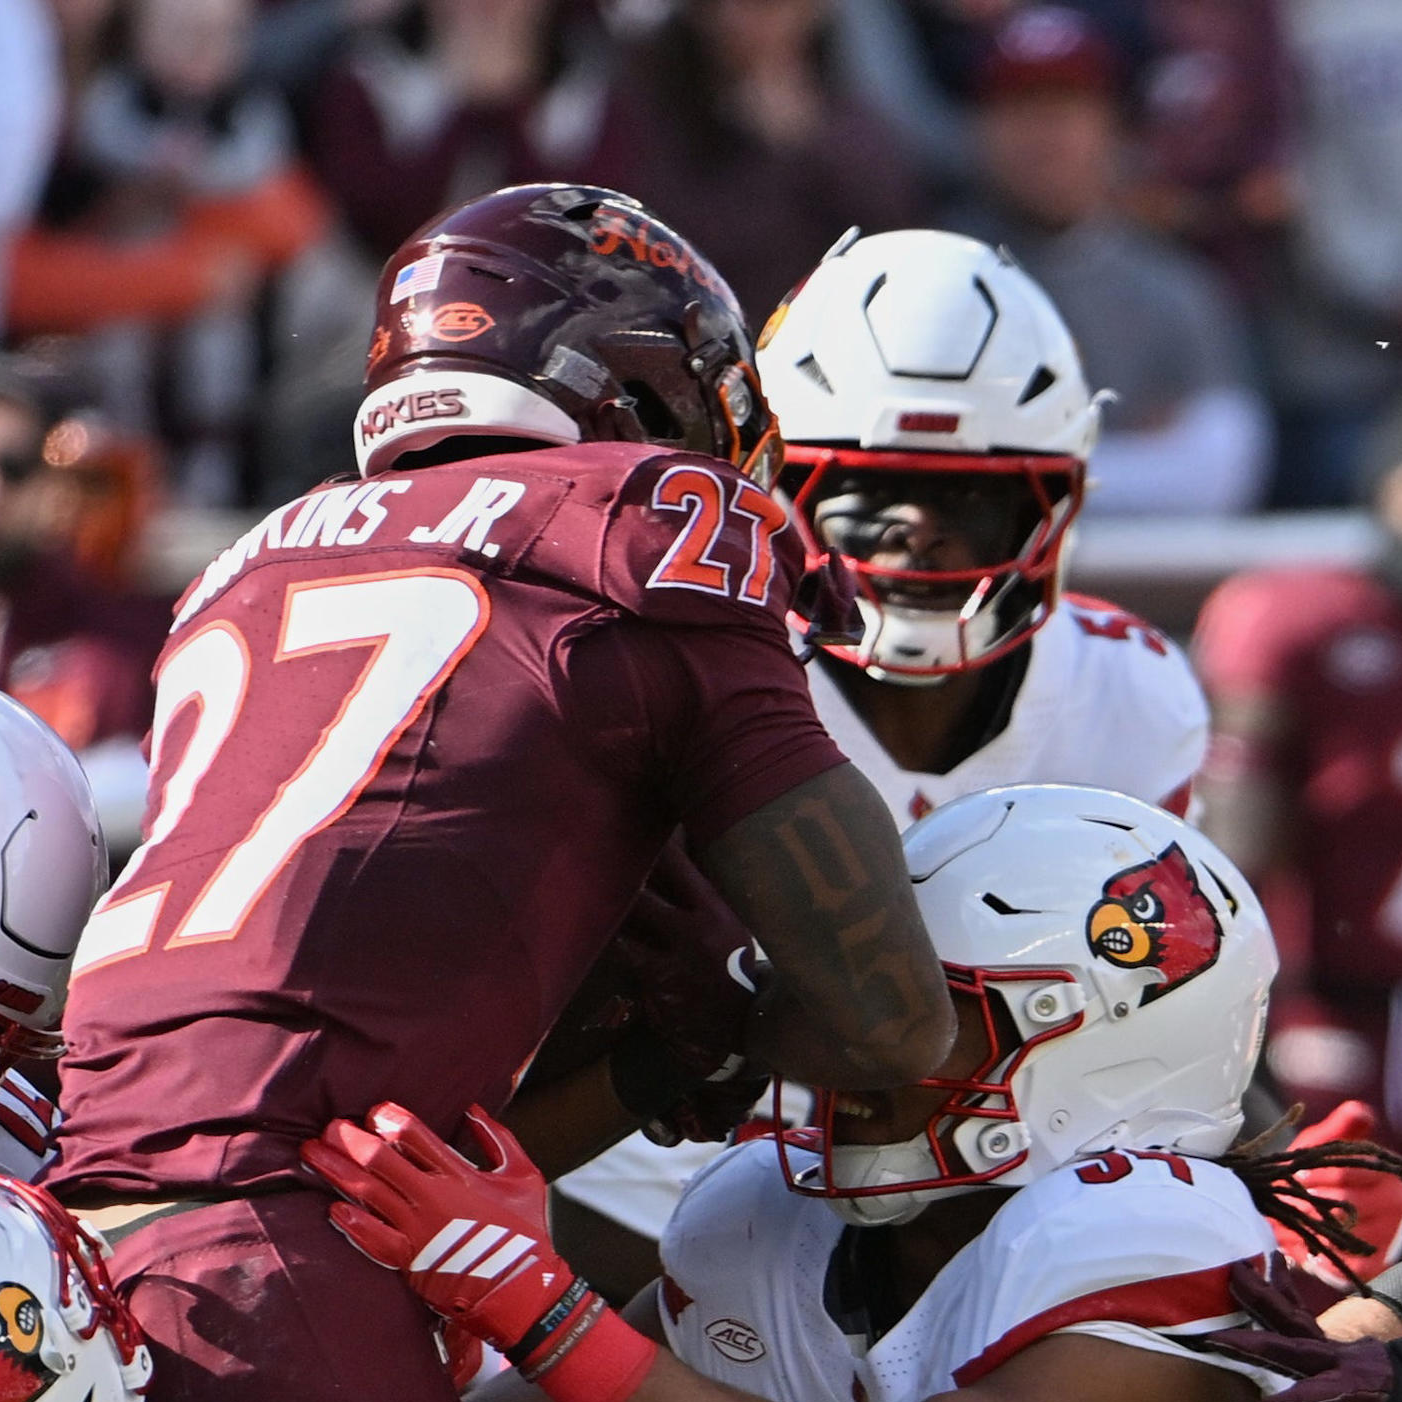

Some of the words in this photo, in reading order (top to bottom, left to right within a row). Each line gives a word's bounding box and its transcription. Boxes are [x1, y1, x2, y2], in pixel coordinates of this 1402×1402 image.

[361, 388, 466, 446] HOKIES
[407, 478, 526, 558] JR.
[646, 465, 788, 606] 27
[67, 566, 492, 990] 27
